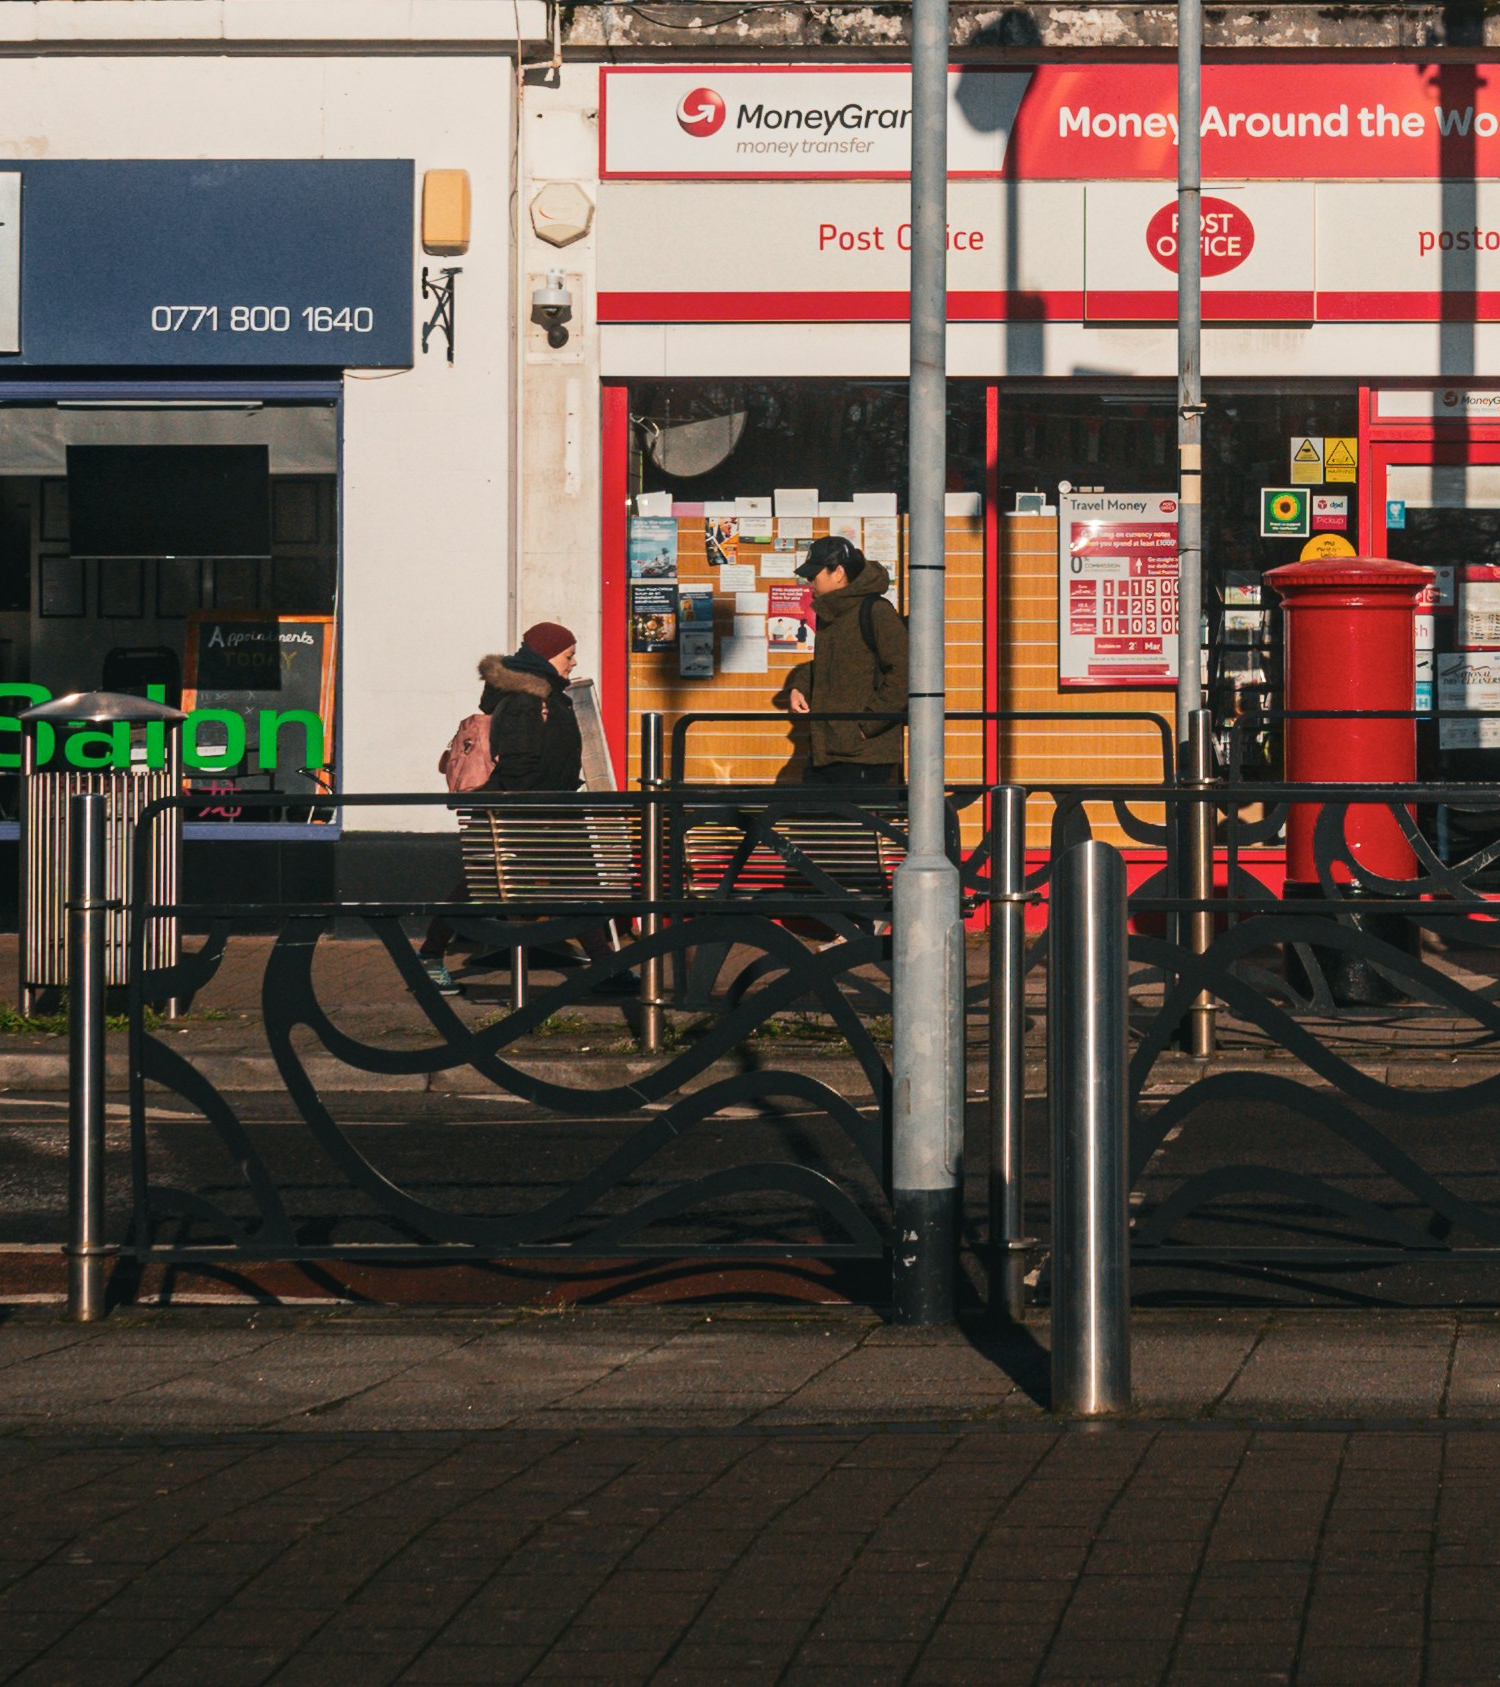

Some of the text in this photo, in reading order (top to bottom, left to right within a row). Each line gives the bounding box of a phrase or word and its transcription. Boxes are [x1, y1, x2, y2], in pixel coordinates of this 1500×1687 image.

[1059, 106, 1179, 145] Money
[1200, 104, 1348, 138] Around
[1358, 104, 1424, 138] the
[736, 138, 874, 158] money transfer
[819, 224, 984, 252] Post Oice
[151, 306, 374, 332] 0771 800 1640
[1071, 499, 1147, 513] Travel Money
[1317, 517, 1344, 525] Pickup
